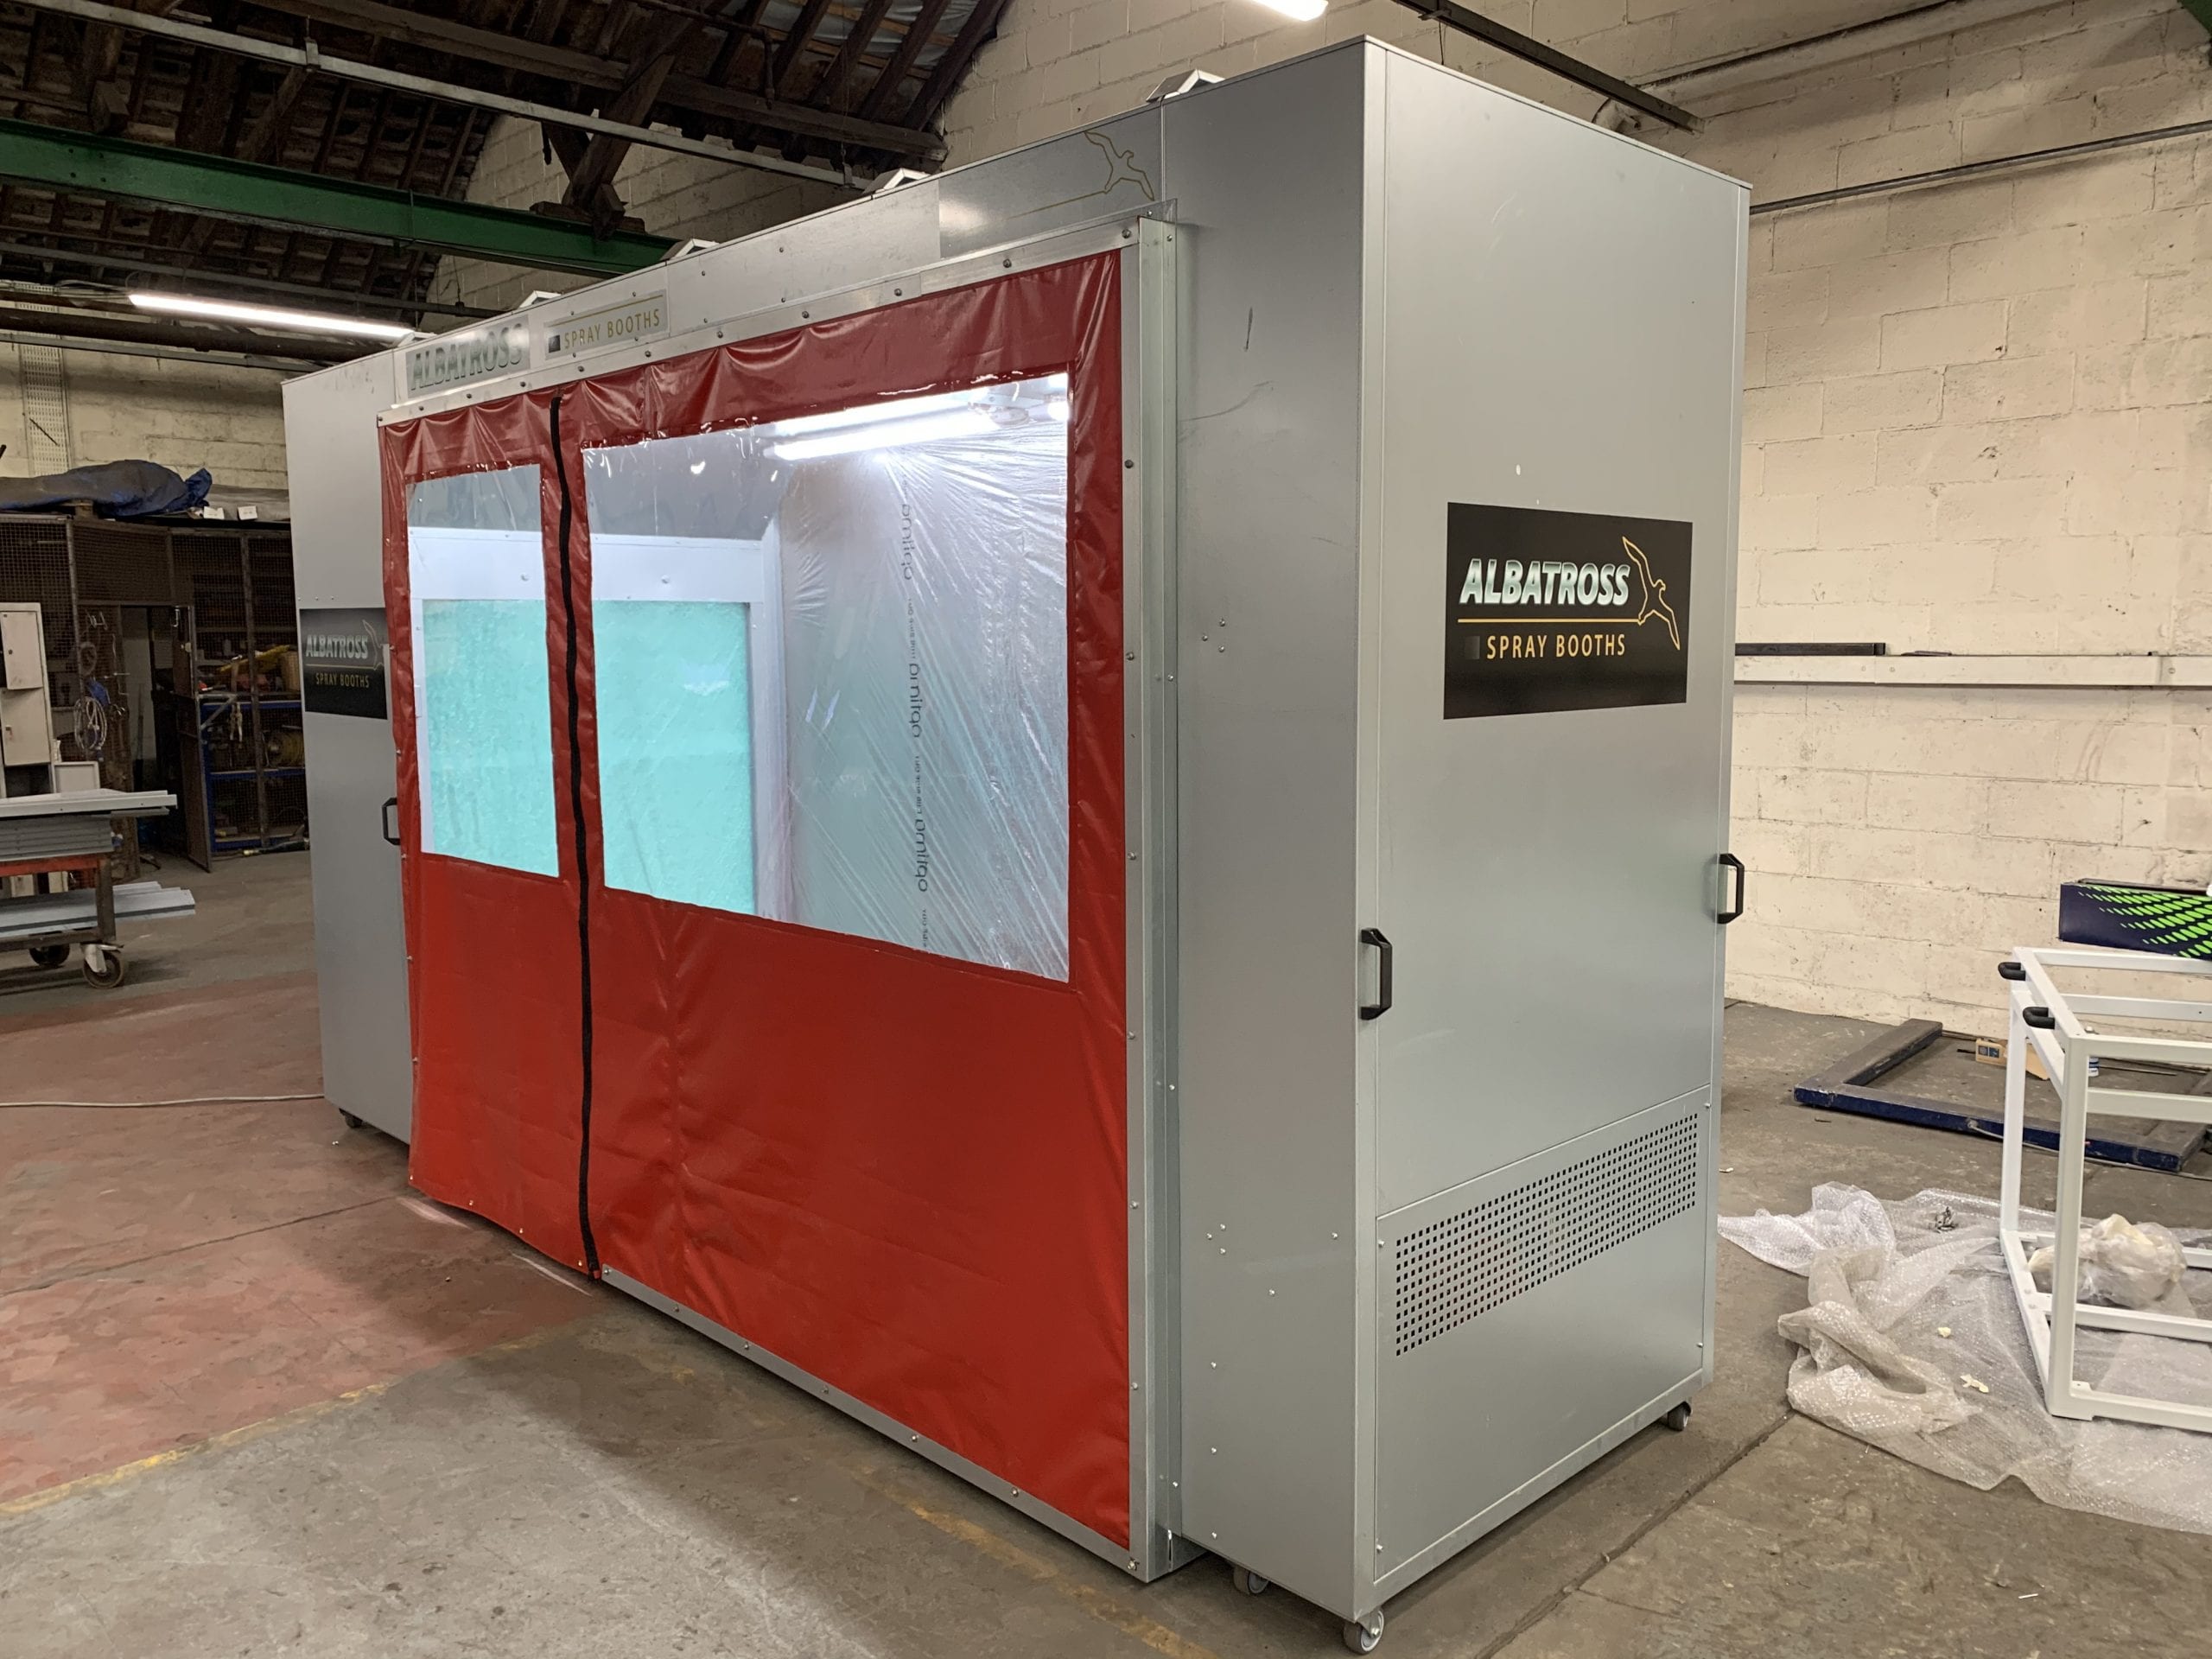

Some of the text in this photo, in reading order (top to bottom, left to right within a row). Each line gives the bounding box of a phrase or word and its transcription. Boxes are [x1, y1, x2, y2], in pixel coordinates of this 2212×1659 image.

[564, 308, 660, 350] SPRAY BOOTHS
[410, 322, 523, 391] ALBATROSS
[1459, 558, 1631, 606] ALBATROSS
[306, 634, 368, 659] ALBATROSS
[1486, 633, 1626, 659] SPRAY BOOTHS
[315, 672, 370, 689] SPRAY BOOTHS
